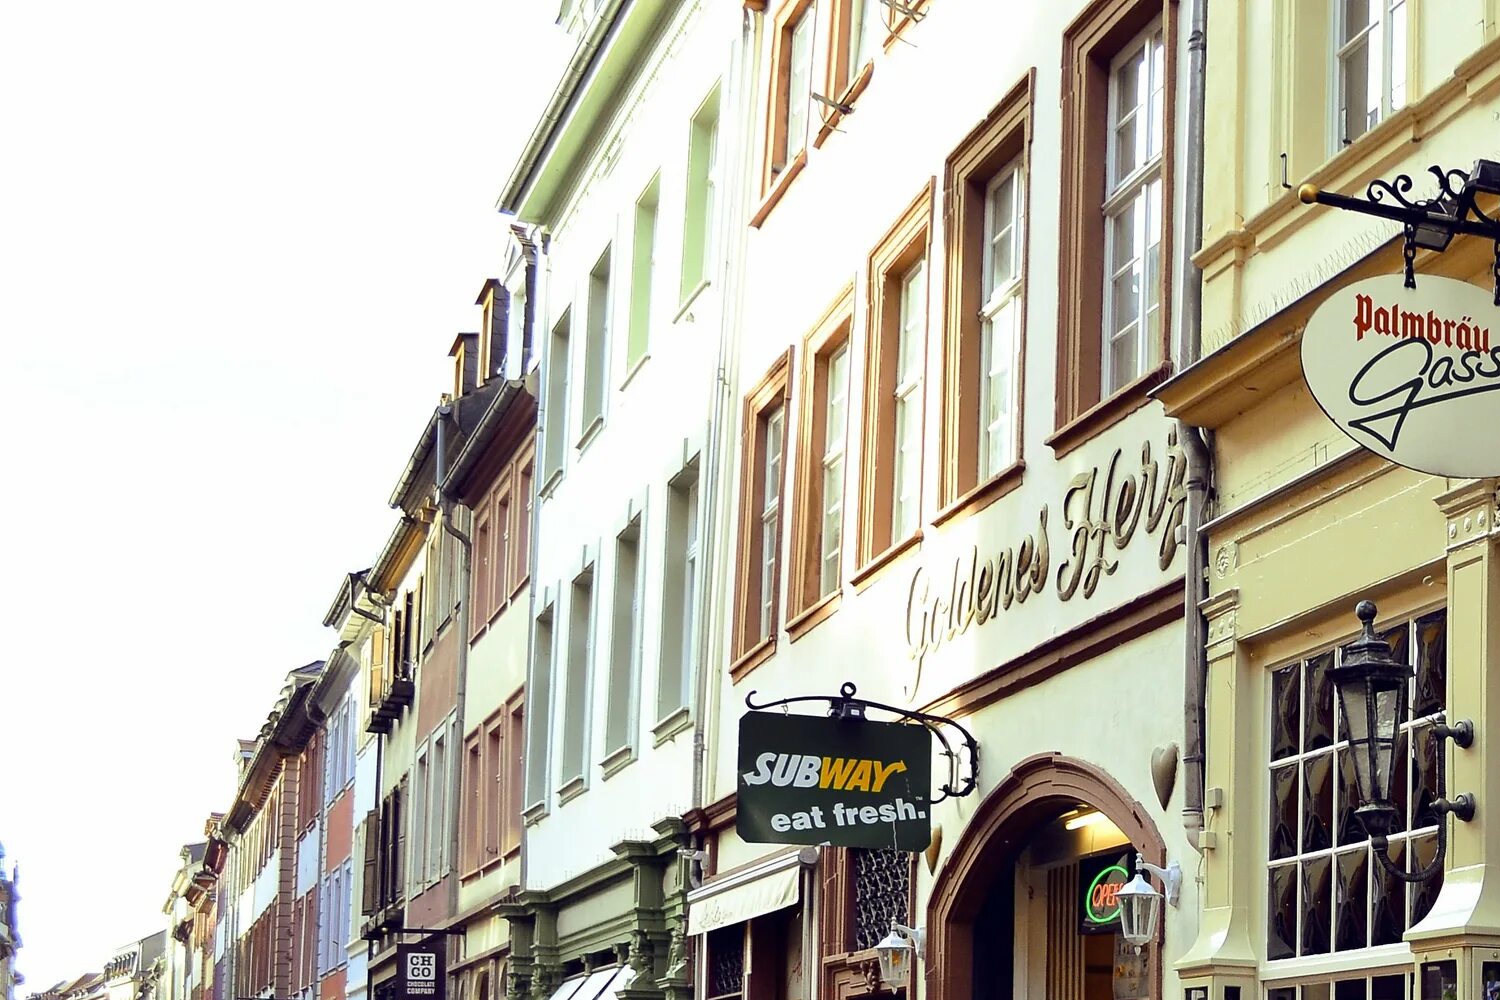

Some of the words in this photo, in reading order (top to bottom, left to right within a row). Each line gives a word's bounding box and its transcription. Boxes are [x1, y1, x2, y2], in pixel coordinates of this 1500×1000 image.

[1353, 293, 1491, 353] Palmbräu
[906, 502, 1050, 703] Goldenes
[743, 752, 908, 792] SUBWAY
[770, 806, 826, 832] eat
[833, 798, 927, 827] fresh.
